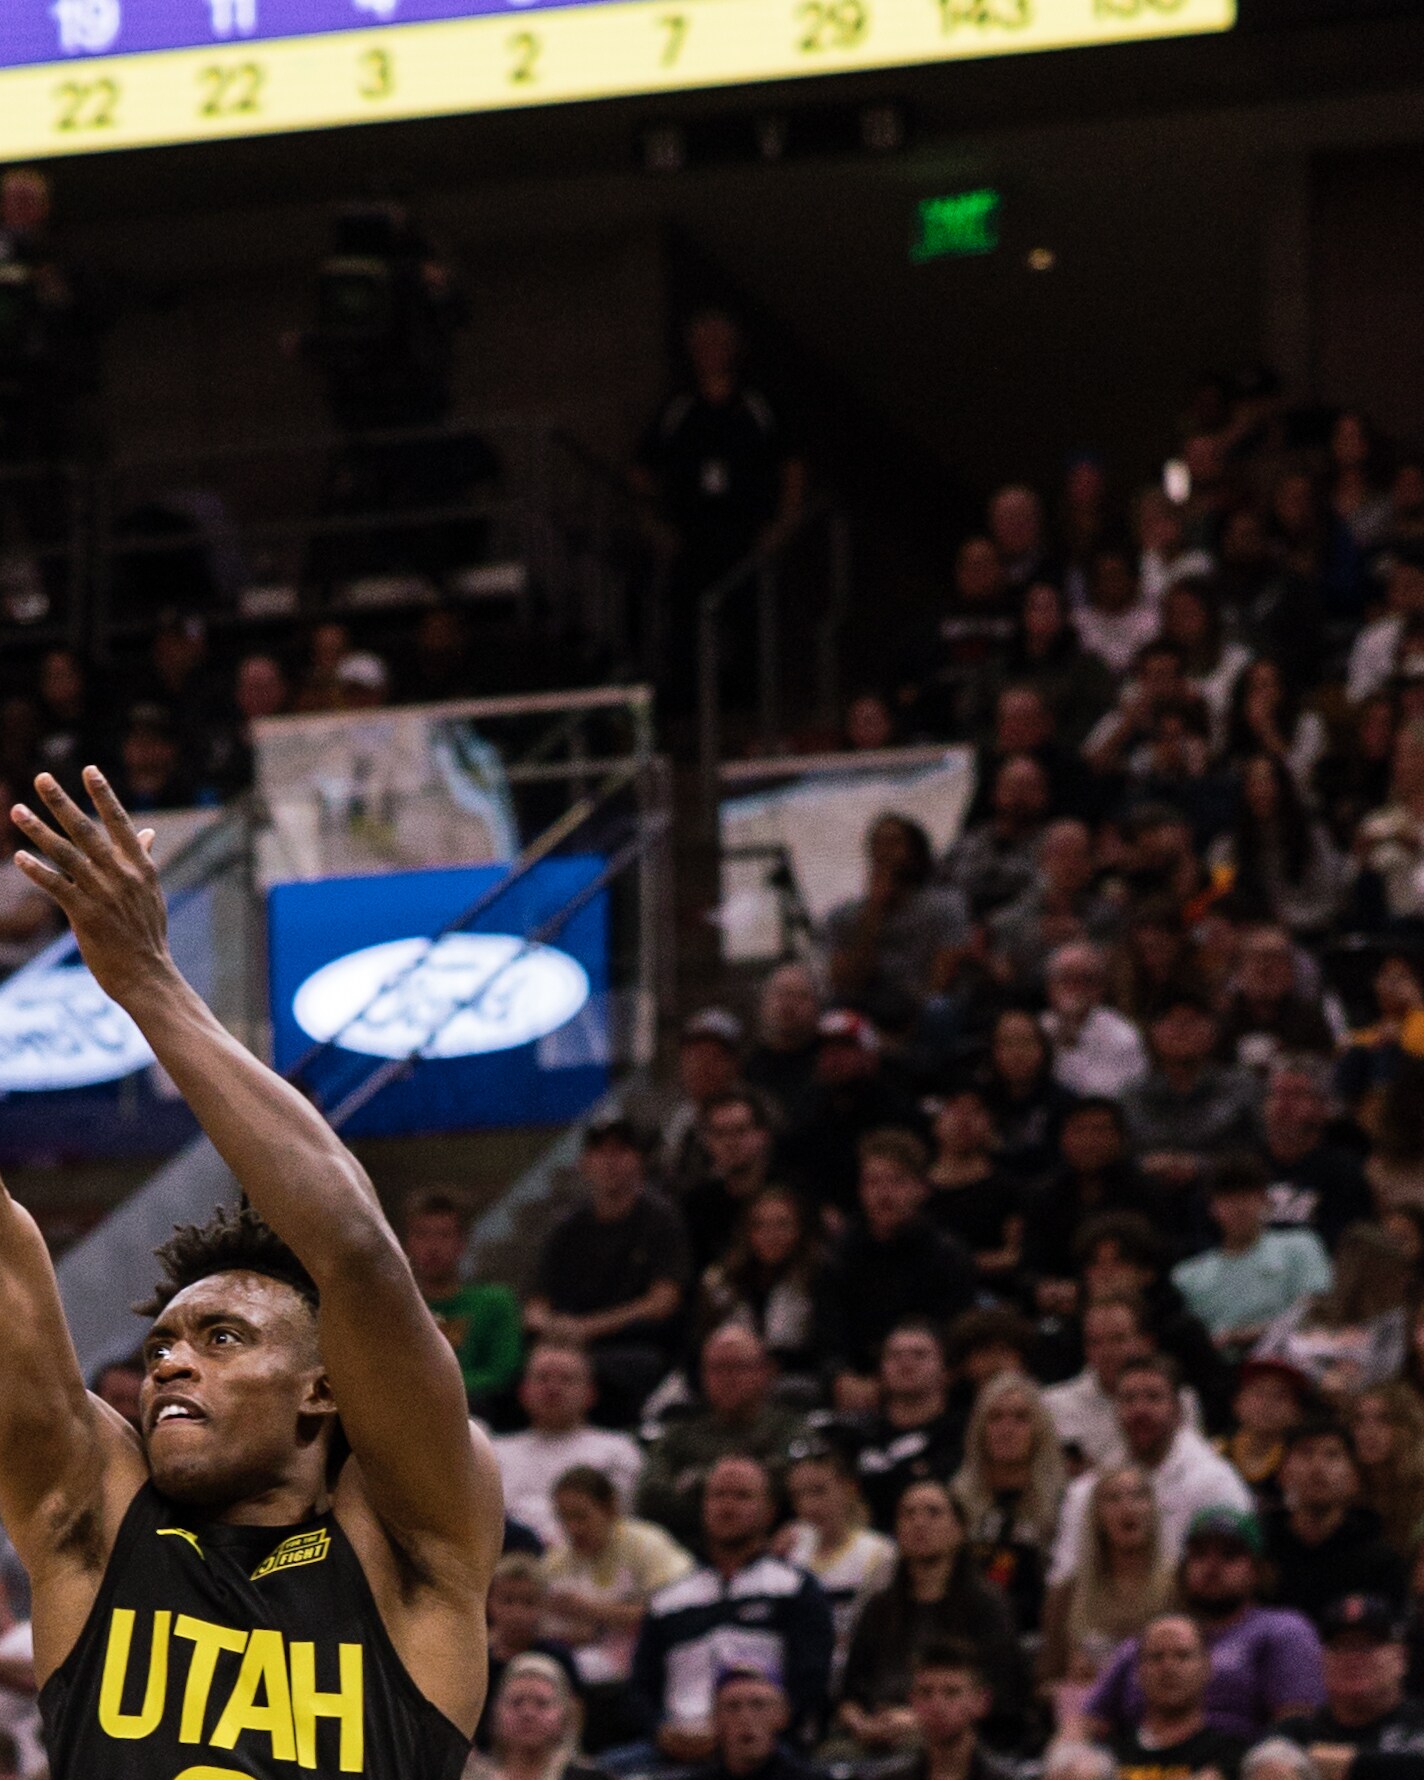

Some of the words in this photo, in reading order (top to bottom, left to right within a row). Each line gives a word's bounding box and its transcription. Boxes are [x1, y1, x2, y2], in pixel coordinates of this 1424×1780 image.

[655, 16, 694, 66] 7
[794, 0, 870, 53] 29
[360, 48, 394, 99] 3
[506, 32, 542, 84] 2
[51, 79, 116, 131] 22
[198, 63, 265, 116] 22
[279, 1544, 323, 1565] FIGHT
[98, 1607, 365, 1773] UTAH
